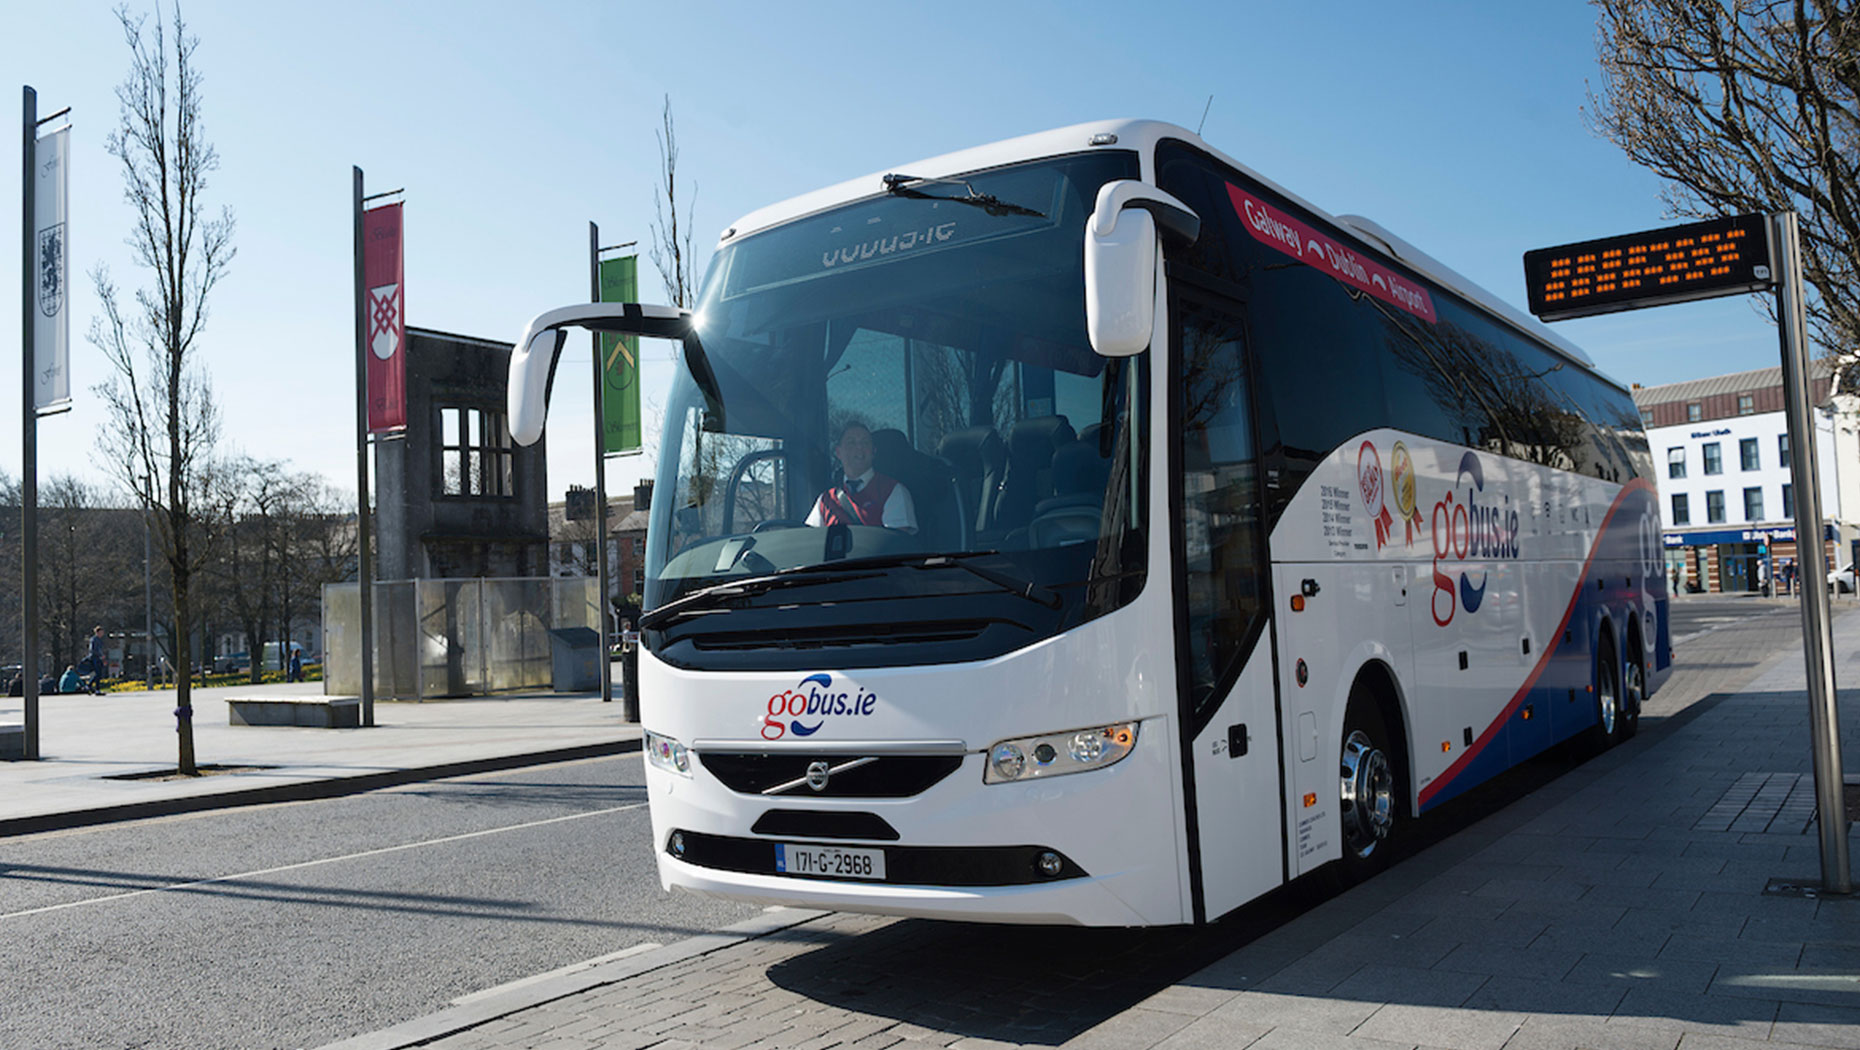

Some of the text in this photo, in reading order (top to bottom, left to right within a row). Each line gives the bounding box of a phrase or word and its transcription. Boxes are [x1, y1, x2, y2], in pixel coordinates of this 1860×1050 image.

[1244, 199, 1428, 314] Galway Dublin Airport
[1432, 488, 1519, 627] gobus.ie
[761, 687, 876, 741] gobus.ie
[796, 851, 872, 875] 171-G-2968
